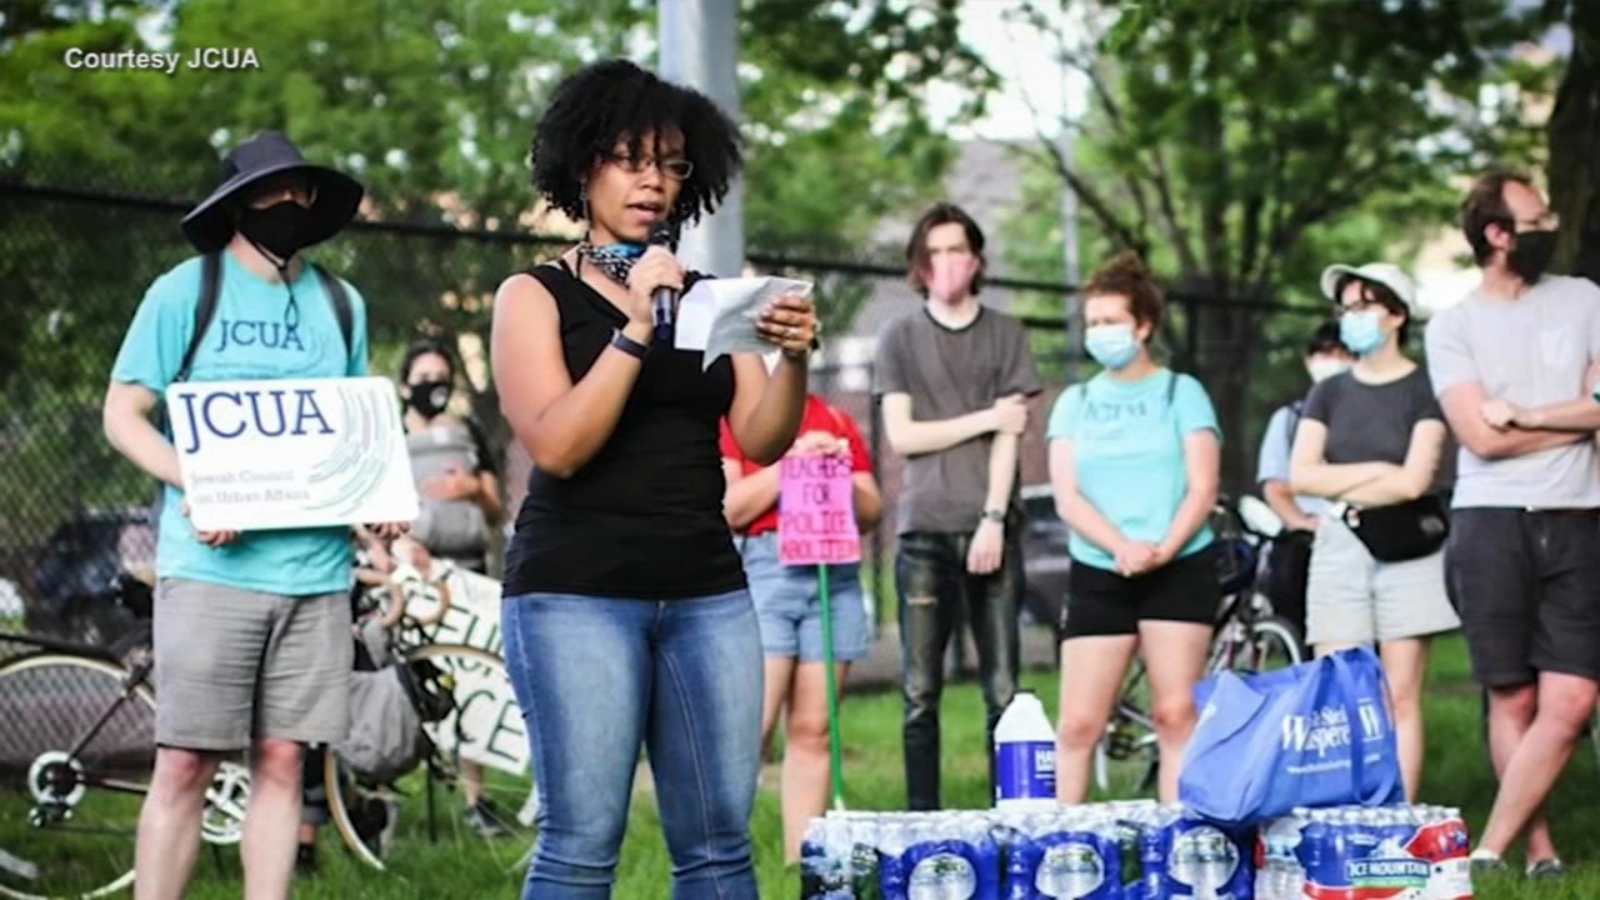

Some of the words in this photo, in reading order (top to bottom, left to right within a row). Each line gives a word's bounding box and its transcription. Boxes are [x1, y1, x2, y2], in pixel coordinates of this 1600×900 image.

[214, 320, 306, 353] JCUA
[178, 389, 335, 454] JCUA
[238, 469, 295, 482] Council
[216, 488, 262, 503] Urban
[802, 482, 830, 506] FOR
[783, 510, 852, 535] POLICE
[1347, 861, 1374, 877] ICE
[1374, 860, 1428, 877] MOUNTAIN
